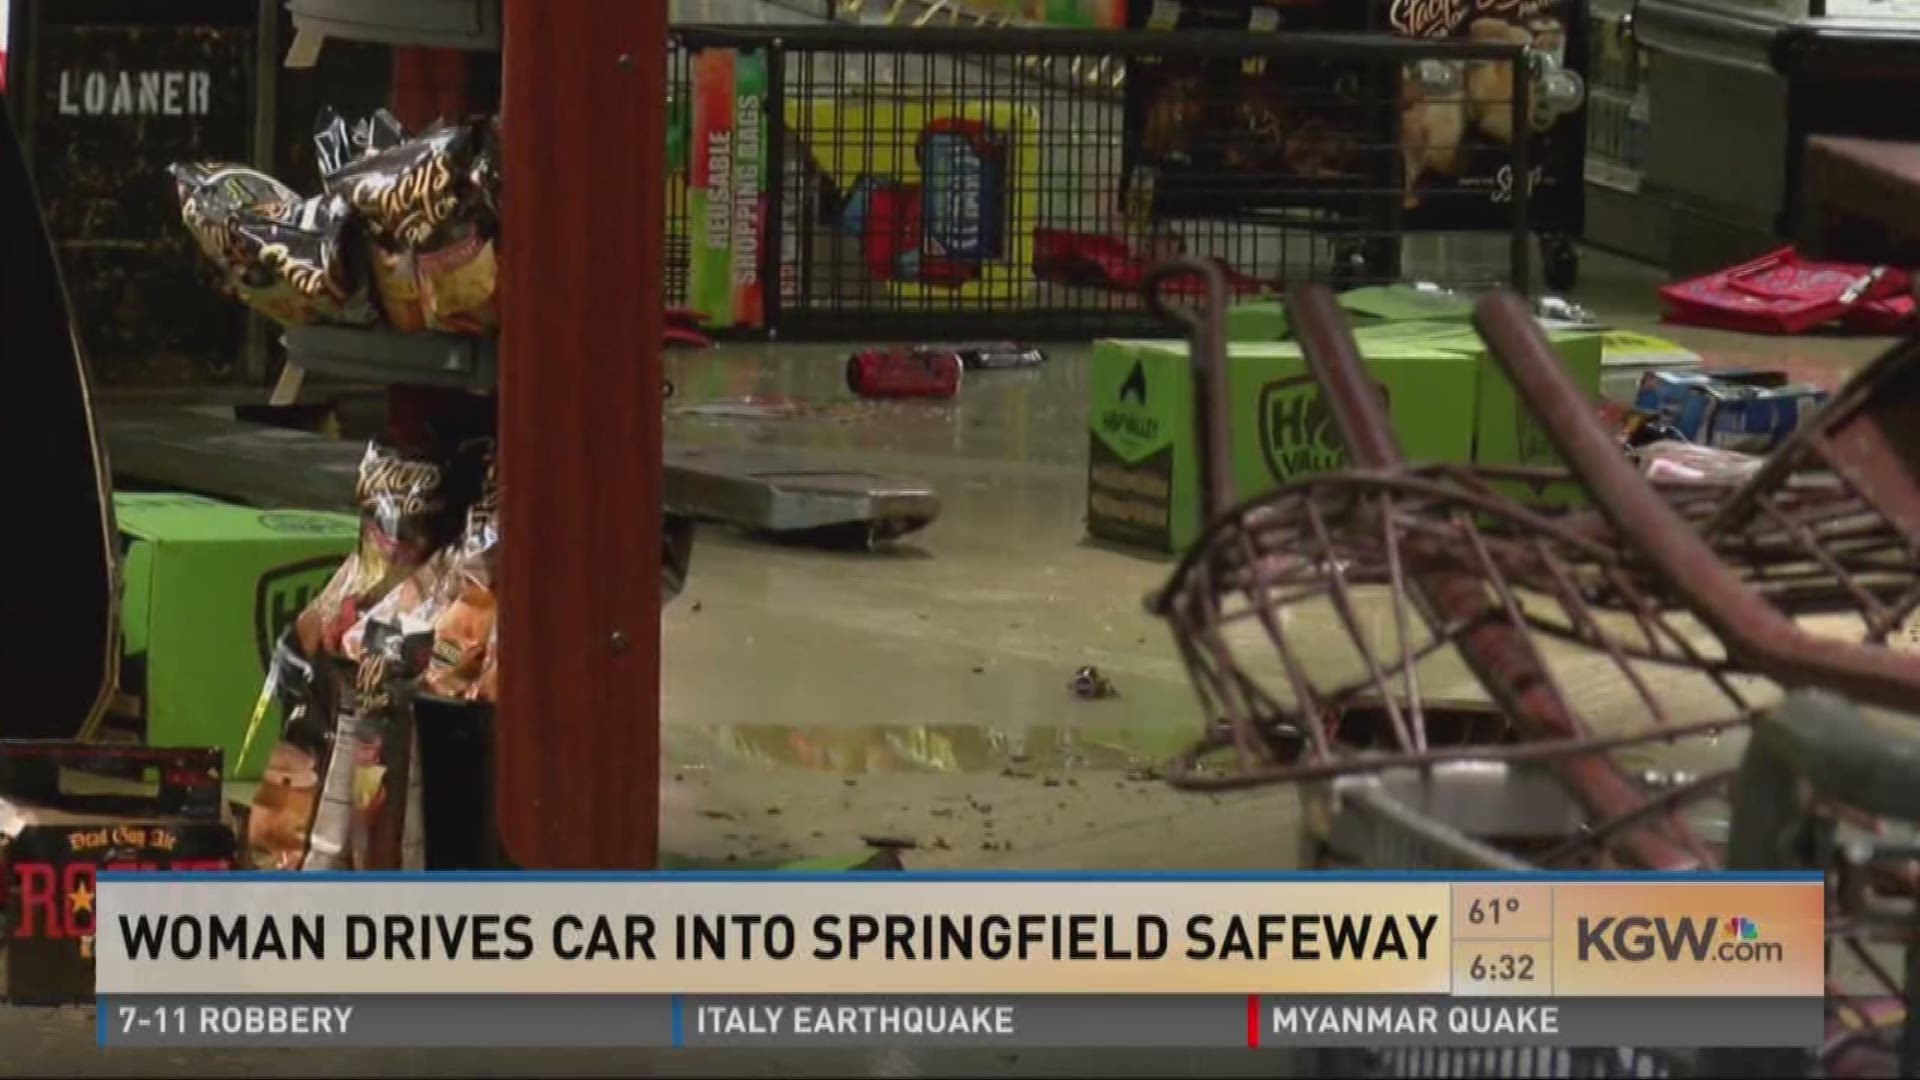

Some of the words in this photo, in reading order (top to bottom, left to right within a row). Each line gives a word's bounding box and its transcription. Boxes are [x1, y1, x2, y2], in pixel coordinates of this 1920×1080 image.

[58, 69, 211, 116] LOANER
[736, 94, 759, 157] BAGS
[708, 130, 732, 249] REUSABLE
[736, 165, 759, 286] SHOPPING
